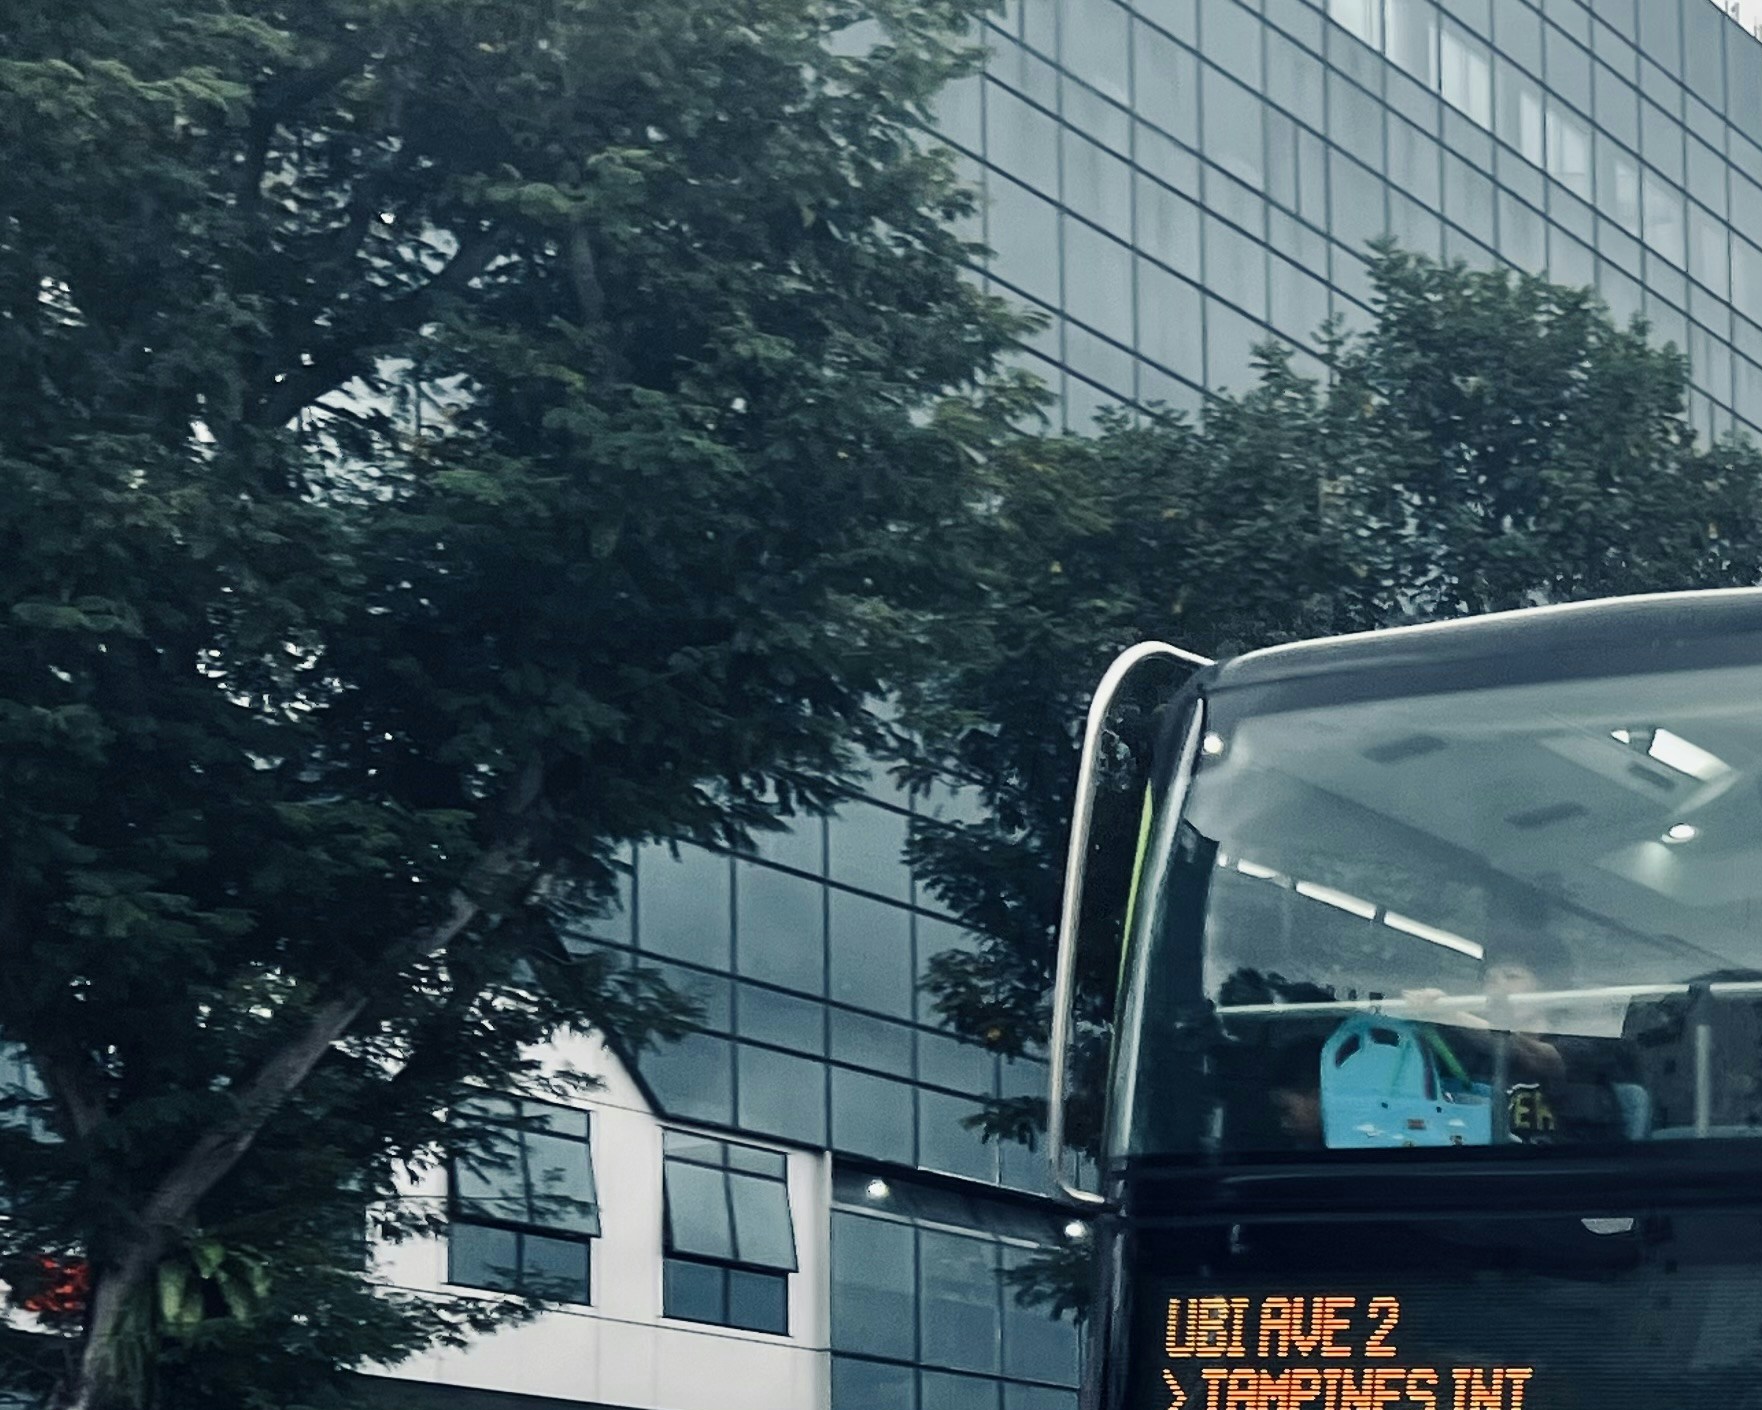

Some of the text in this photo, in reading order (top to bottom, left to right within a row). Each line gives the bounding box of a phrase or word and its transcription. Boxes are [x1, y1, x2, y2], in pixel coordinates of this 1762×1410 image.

[1165, 1296, 1400, 1358] UBI AVE 2
